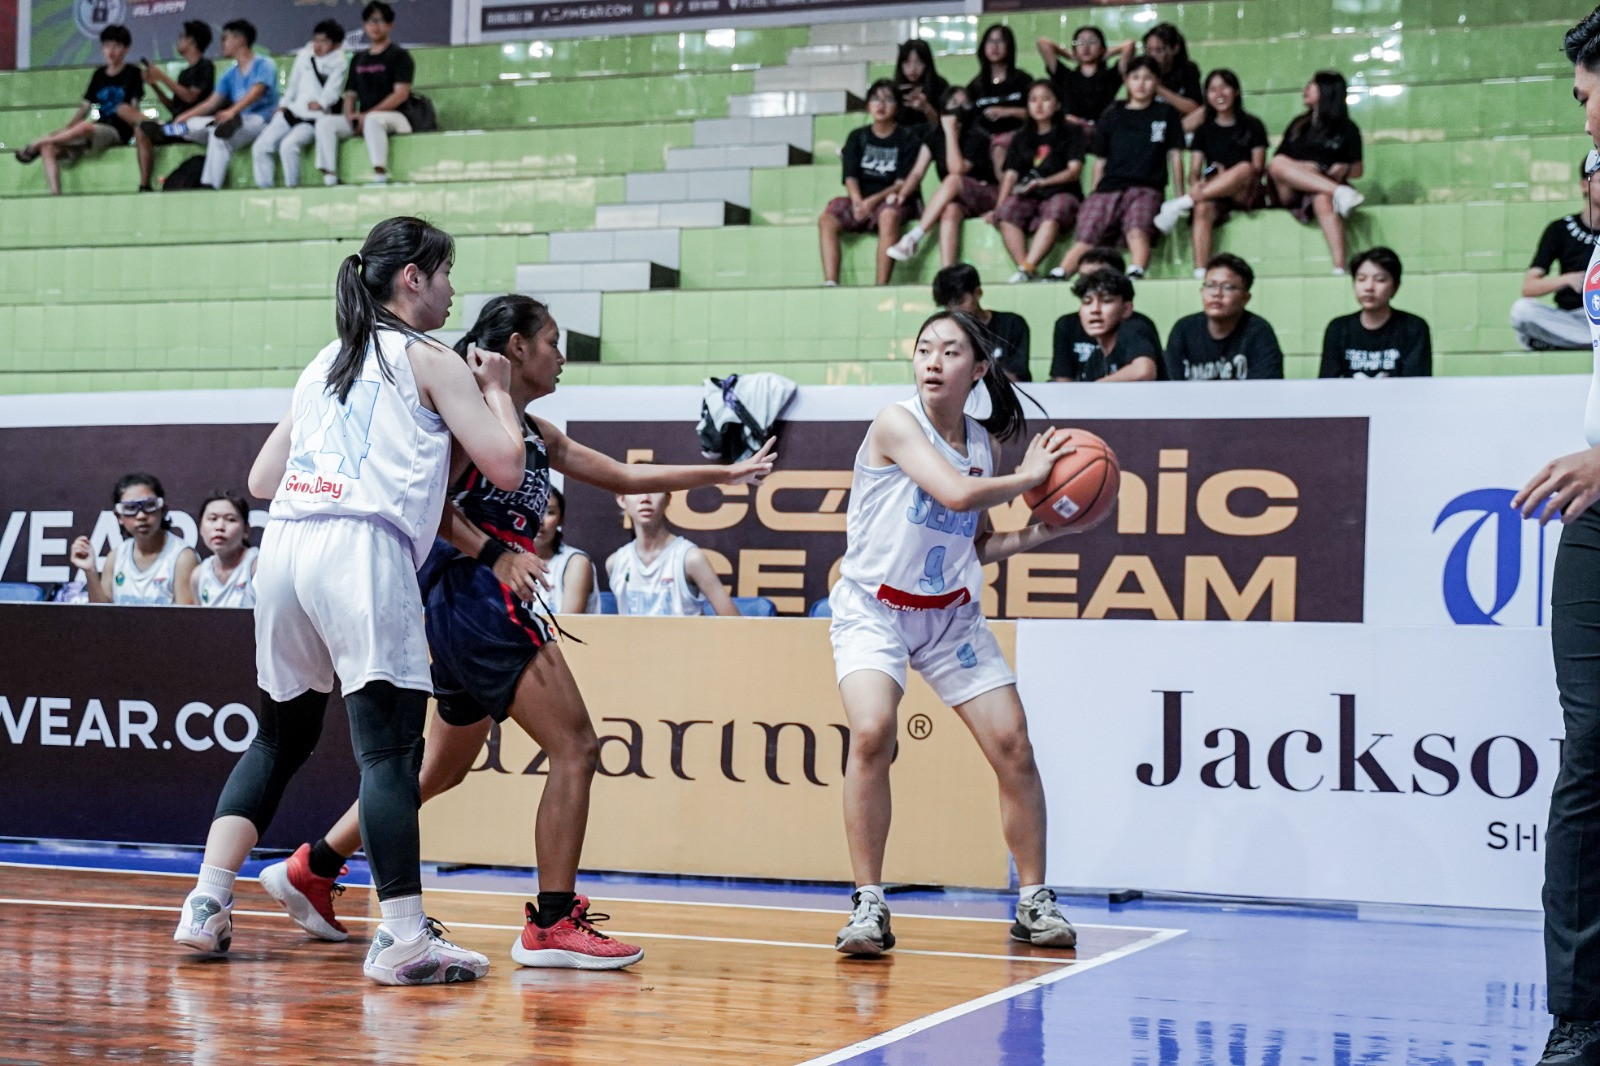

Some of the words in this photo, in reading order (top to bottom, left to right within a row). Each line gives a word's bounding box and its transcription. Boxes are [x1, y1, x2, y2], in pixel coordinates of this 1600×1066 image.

[314, 476, 343, 499] Day
[507, 509, 527, 531] 7
[919, 545, 946, 594] 9
[956, 642, 978, 669] 9
